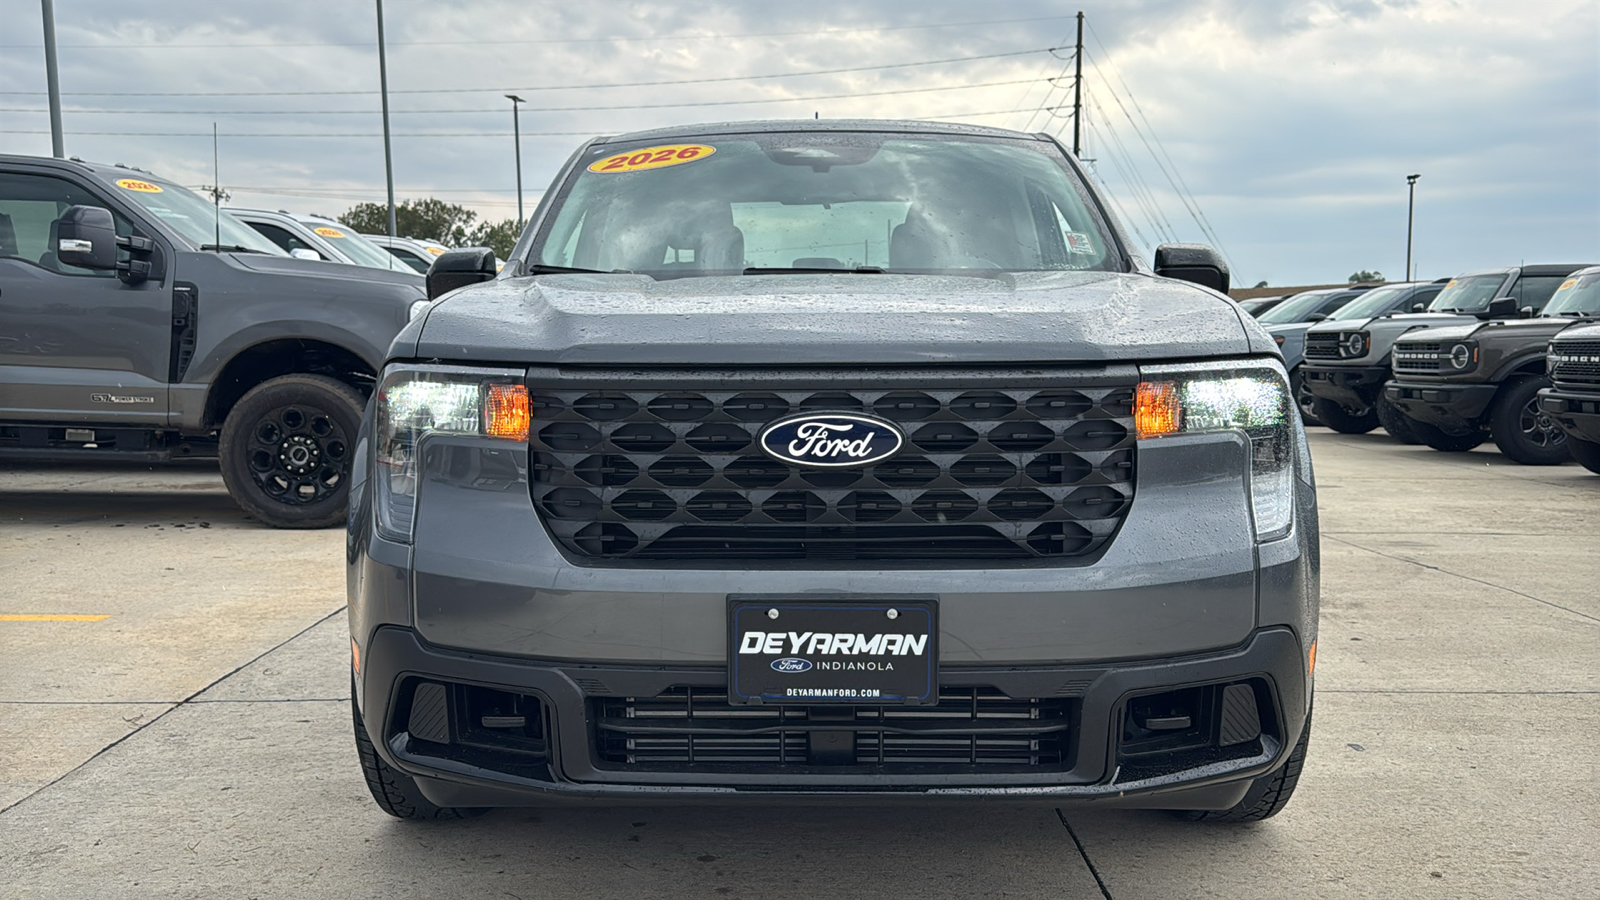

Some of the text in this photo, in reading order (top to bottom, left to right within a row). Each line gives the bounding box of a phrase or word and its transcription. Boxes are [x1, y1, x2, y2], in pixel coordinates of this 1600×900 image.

[601, 147, 702, 171] 2026
[788, 422, 875, 457] Ford
[739, 631, 928, 655] DEYARMAN
[779, 658, 894, 671] Ford INDIANOLA
[786, 688, 880, 697] DEYARMANFORD.COM
